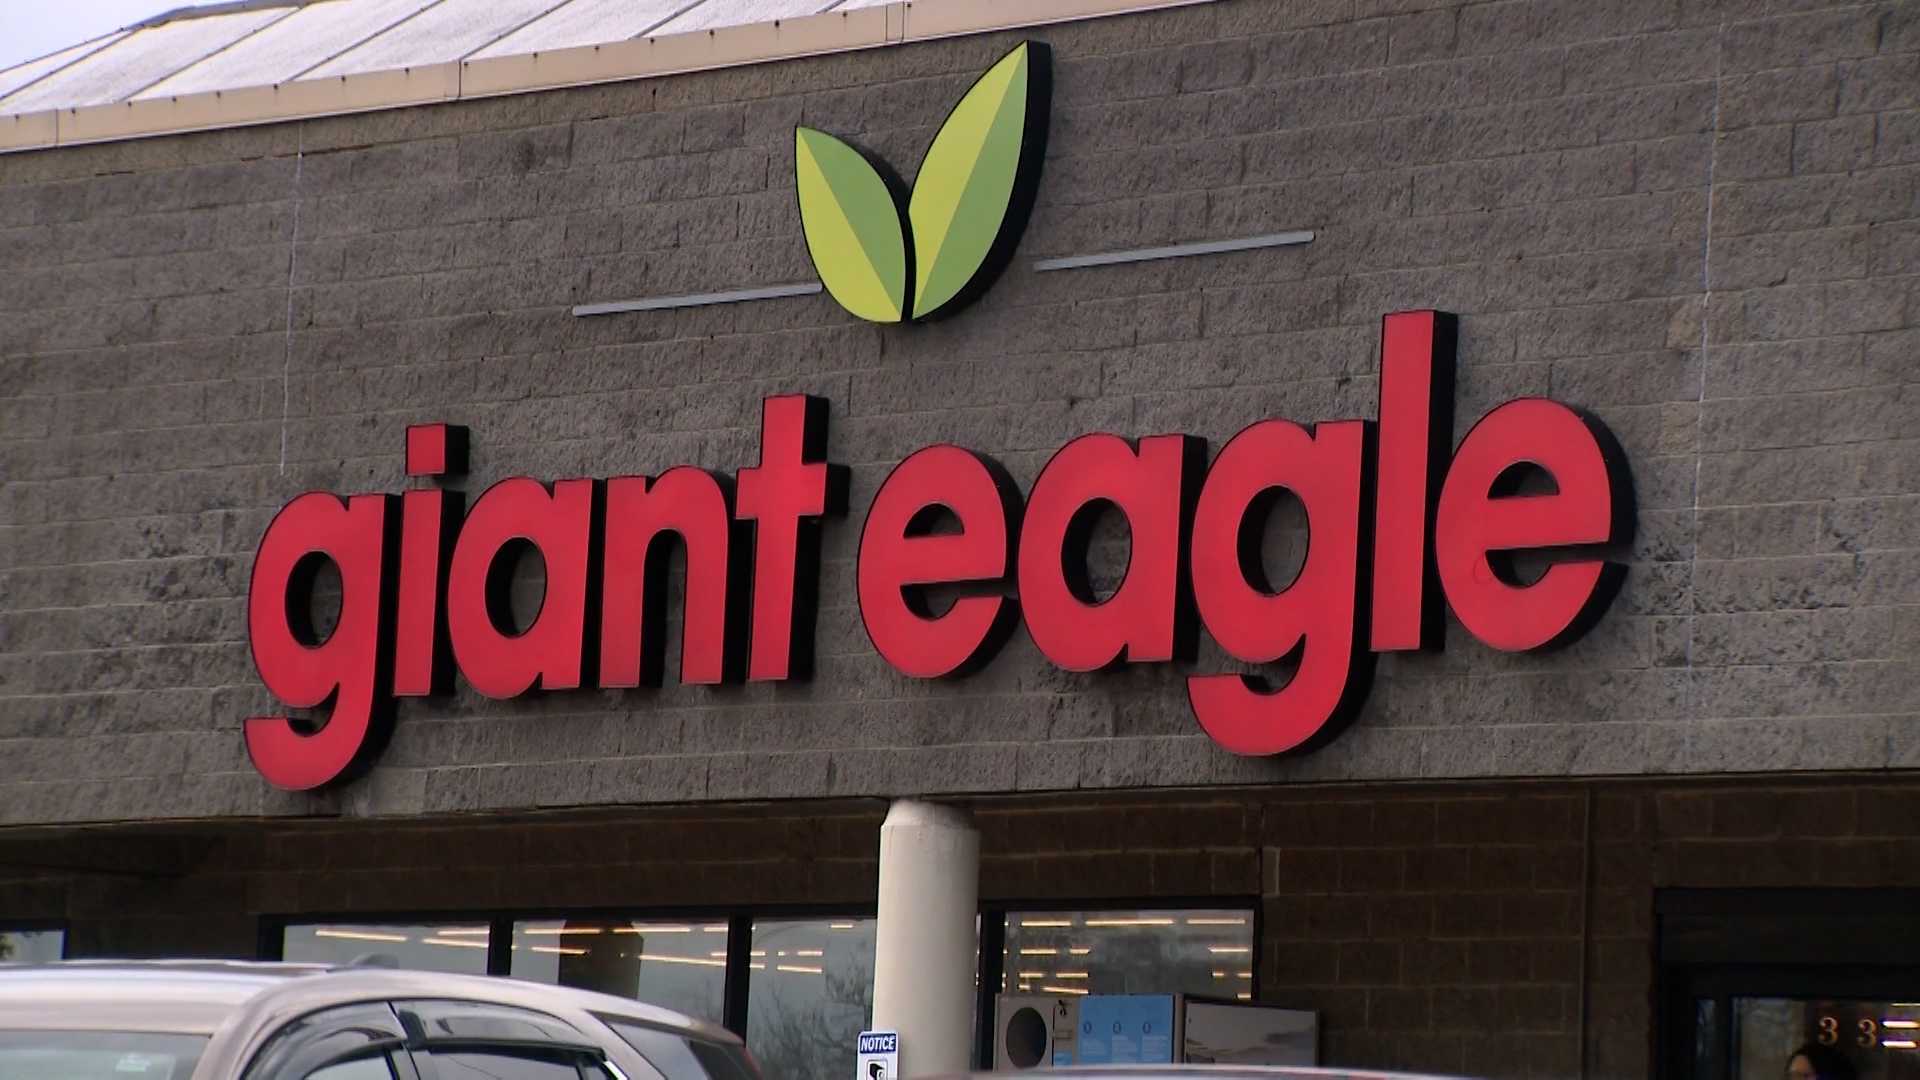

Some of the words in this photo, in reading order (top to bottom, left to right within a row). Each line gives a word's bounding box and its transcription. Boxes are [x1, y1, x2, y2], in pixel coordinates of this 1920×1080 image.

[246, 396, 830, 789] giant
[858, 311, 1618, 754] eagle
[860, 1036, 896, 1051] NOTICE
